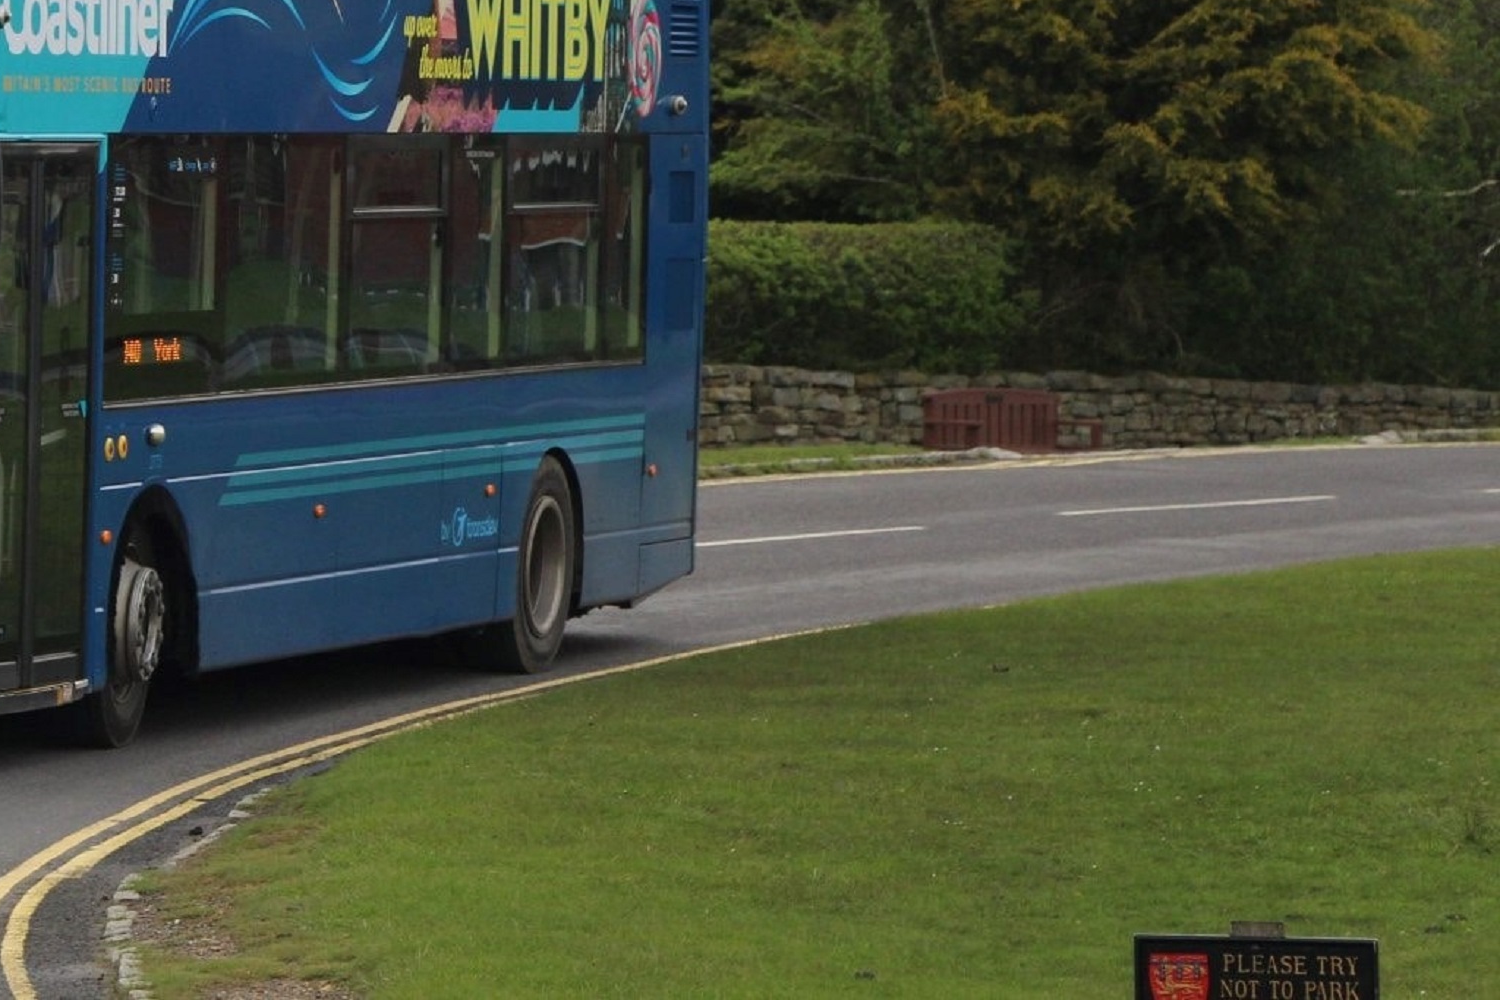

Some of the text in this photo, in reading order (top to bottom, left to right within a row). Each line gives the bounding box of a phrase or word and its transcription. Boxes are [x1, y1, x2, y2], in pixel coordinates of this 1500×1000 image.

[141, 76, 172, 95] ROUTE
[1222, 953, 1359, 976] PLEASE TRY
[1219, 979, 1360, 1000] NOT TO PARK
